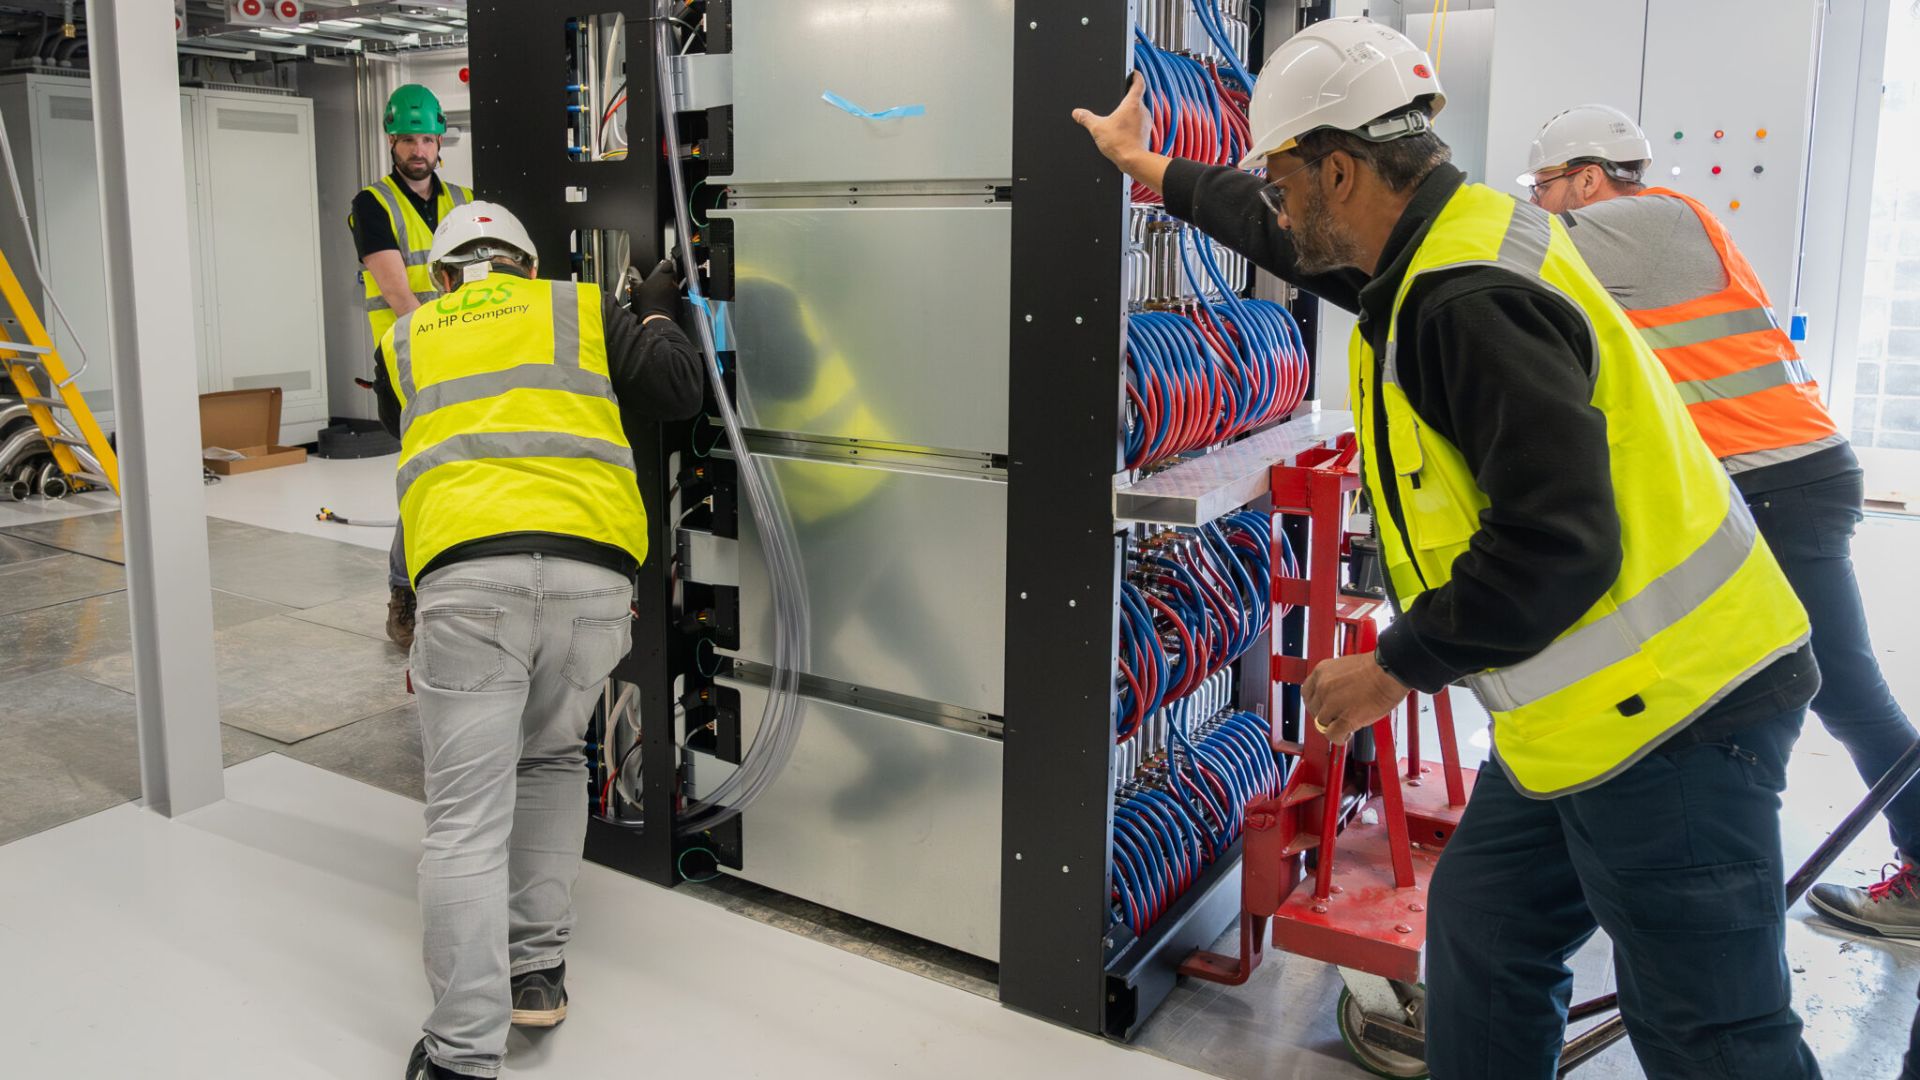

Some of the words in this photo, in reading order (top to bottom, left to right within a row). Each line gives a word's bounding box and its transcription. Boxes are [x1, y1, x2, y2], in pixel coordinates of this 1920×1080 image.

[436, 282, 515, 314] CDS
[416, 323, 434, 336] An
[438, 315, 458, 328] HP
[462, 303, 530, 323] Company
